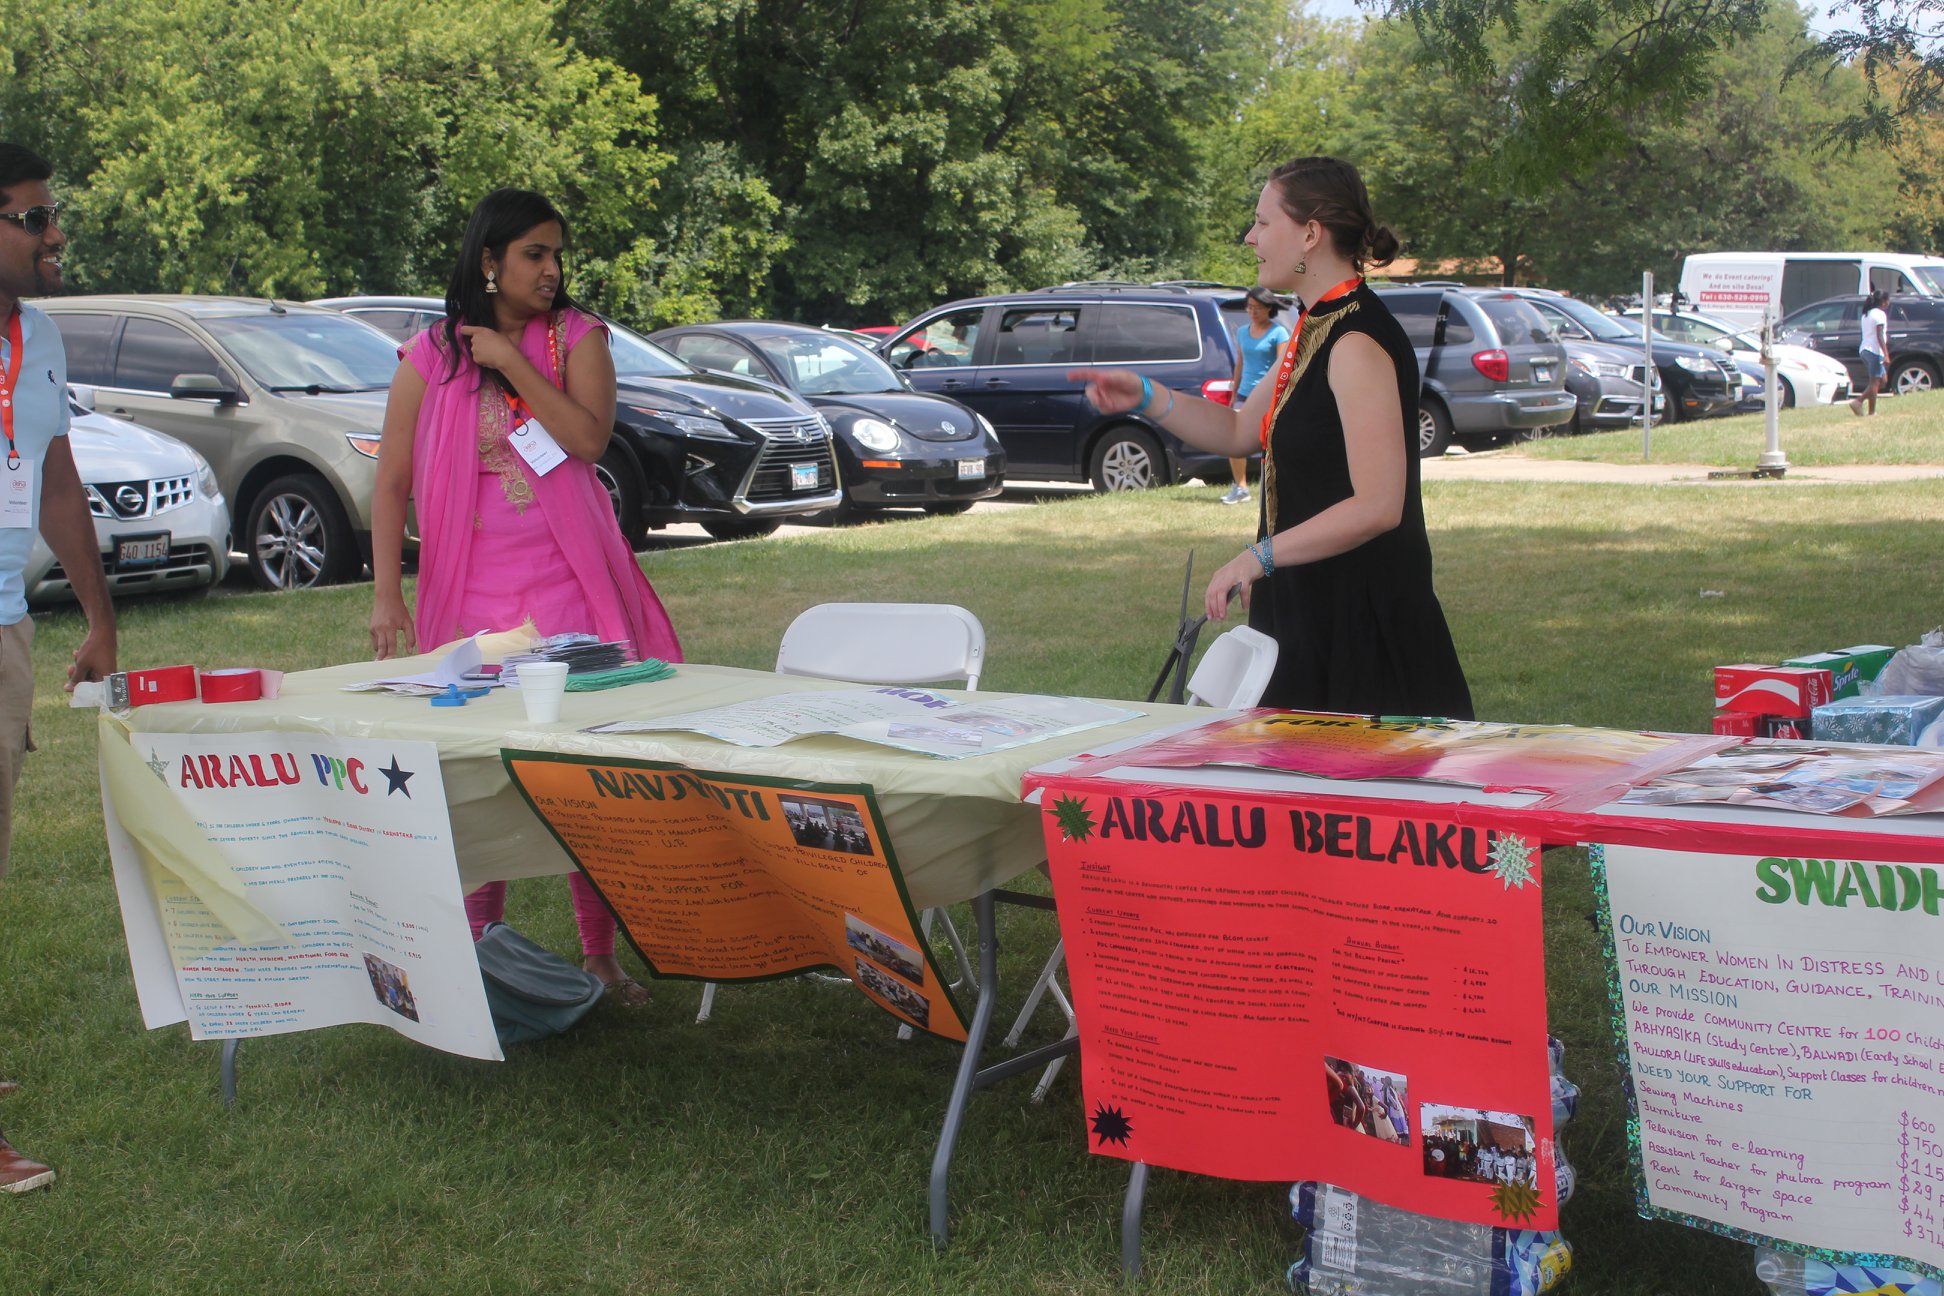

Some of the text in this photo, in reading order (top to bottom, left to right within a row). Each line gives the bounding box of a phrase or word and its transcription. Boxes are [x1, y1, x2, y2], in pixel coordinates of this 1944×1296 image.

[1833, 666, 1859, 692] Sprite
[181, 753, 369, 794] ARALU PPC
[557, 797, 598, 809] VISION
[1100, 797, 1498, 874] ARALU BELAKU
[1620, 914, 1711, 943] OUR VISION
[1625, 960, 1686, 979] THROUGH
[1699, 969, 1779, 993] EDUCATION,
[1786, 979, 1872, 1000] GUIDANCE,
[1645, 942, 1709, 963] EMPOWER
[1716, 950, 1768, 970] WOMEN
[1777, 954, 1793, 970] IN
[1800, 957, 1885, 975] DISTRESS
[1896, 964, 1929, 982] AND
[1629, 979, 1738, 1008] OUR MISSION
[1632, 1000, 1649, 1014] We
[1656, 1006, 1695, 1022] provide
[1704, 1013, 1772, 1034] COMMUNITY
[1777, 1021, 1832, 1038] CENTRE
[1839, 1026, 1859, 1040] for
[1864, 1028, 1901, 1042] 100
[1634, 1020, 1701, 1044] ABHYASIKA
[1706, 1032, 1746, 1056] (Study
[1801, 1046, 1858, 1062] BALWADI
[1902, 1054, 1933, 1071] School
[1633, 1042, 1681, 1061] PHULORA
[1787, 1066, 1828, 1084] Support
[1831, 1070, 1867, 1083] Classes
[1872, 1071, 1888, 1083] for
[1891, 1073, 1936, 1095] children
[1637, 1062, 1813, 1101] NEED YOUR SUPPORT FOR
[1639, 1081, 1677, 1106] Sewing
[1683, 1092, 1744, 1113] Machines
[1642, 1100, 1703, 1124] Furniture
[1646, 1119, 1699, 1142] Television
[1705, 1134, 1722, 1147] for
[1732, 1141, 1805, 1171] e-learning
[1648, 1141, 1696, 1161] Assistant
[1700, 1152, 1741, 1170] Teacher
[1750, 1163, 1767, 1176] for
[1776, 1170, 1824, 1185] phulora
[1833, 1179, 1891, 1196] program
[1650, 1159, 1681, 1176] Rent
[1693, 1170, 1711, 1183] for
[1720, 1176, 1762, 1199] larger
[1773, 1190, 1814, 1207] space
[1655, 1178, 1728, 1211] Community
[1740, 1201, 1794, 1223] Program
